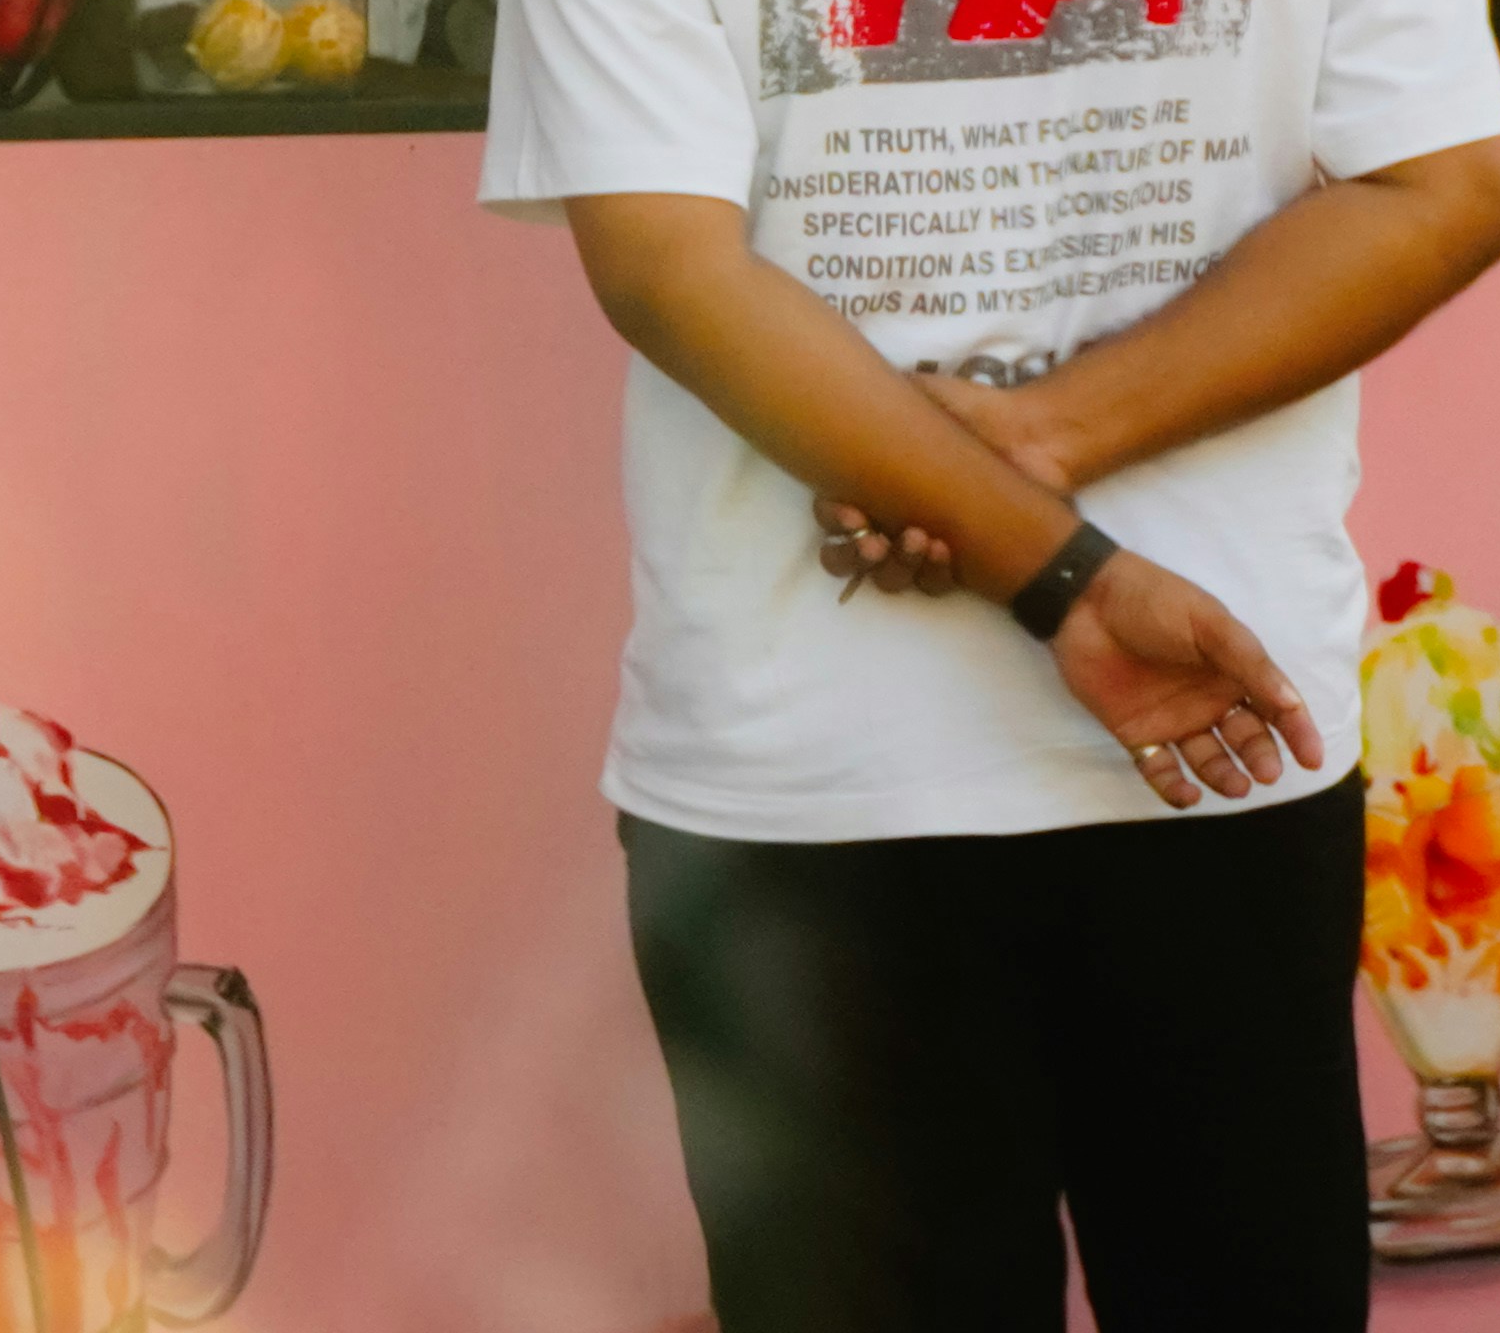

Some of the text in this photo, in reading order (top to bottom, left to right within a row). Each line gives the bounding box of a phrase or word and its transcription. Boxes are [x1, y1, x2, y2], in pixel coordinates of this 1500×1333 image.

[824, 128, 852, 155] IN
[858, 125, 955, 156] TRUTH,
[961, 120, 1029, 150] WHAT
[767, 166, 976, 201] ONSIDERATIONS
[981, 164, 1019, 191] ON
[1027, 159, 1064, 188] TH
[1159, 138, 1196, 166] OF
[802, 207, 982, 238] SPECIFICALLY
[989, 203, 1036, 231] HIS
[806, 252, 953, 282] CONDITION
[960, 249, 995, 277] AS
[1149, 219, 1197, 246] HIS
[910, 291, 968, 317] AND
